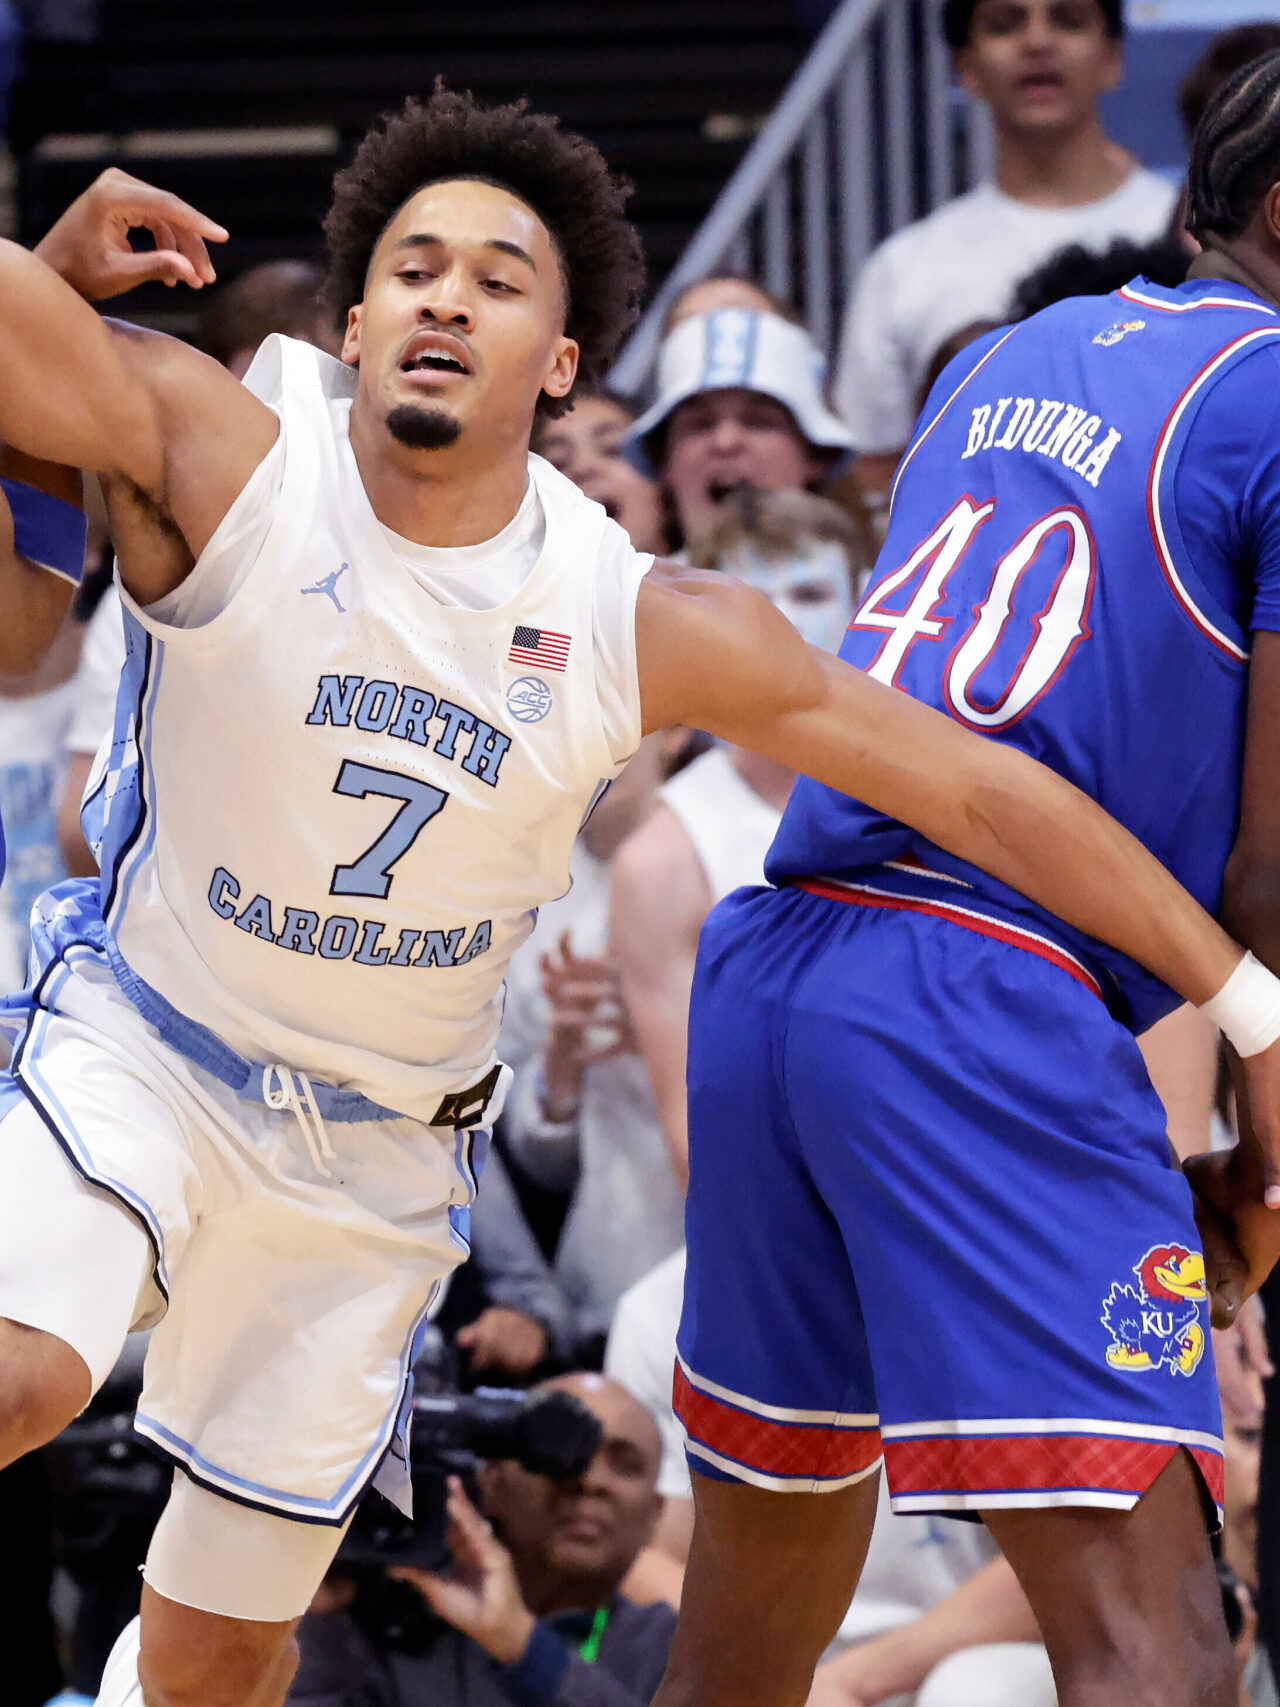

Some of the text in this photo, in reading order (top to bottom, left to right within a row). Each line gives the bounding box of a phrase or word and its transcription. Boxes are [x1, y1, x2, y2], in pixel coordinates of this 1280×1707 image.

[961, 396, 1122, 488] BIDUNGA
[847, 492, 1097, 733] 40
[304, 674, 512, 788] NORTH
[512, 690, 550, 707] ACC
[328, 758, 450, 900] 7
[207, 866, 492, 968] CAROLINA
[1140, 1311, 1173, 1338] KU
